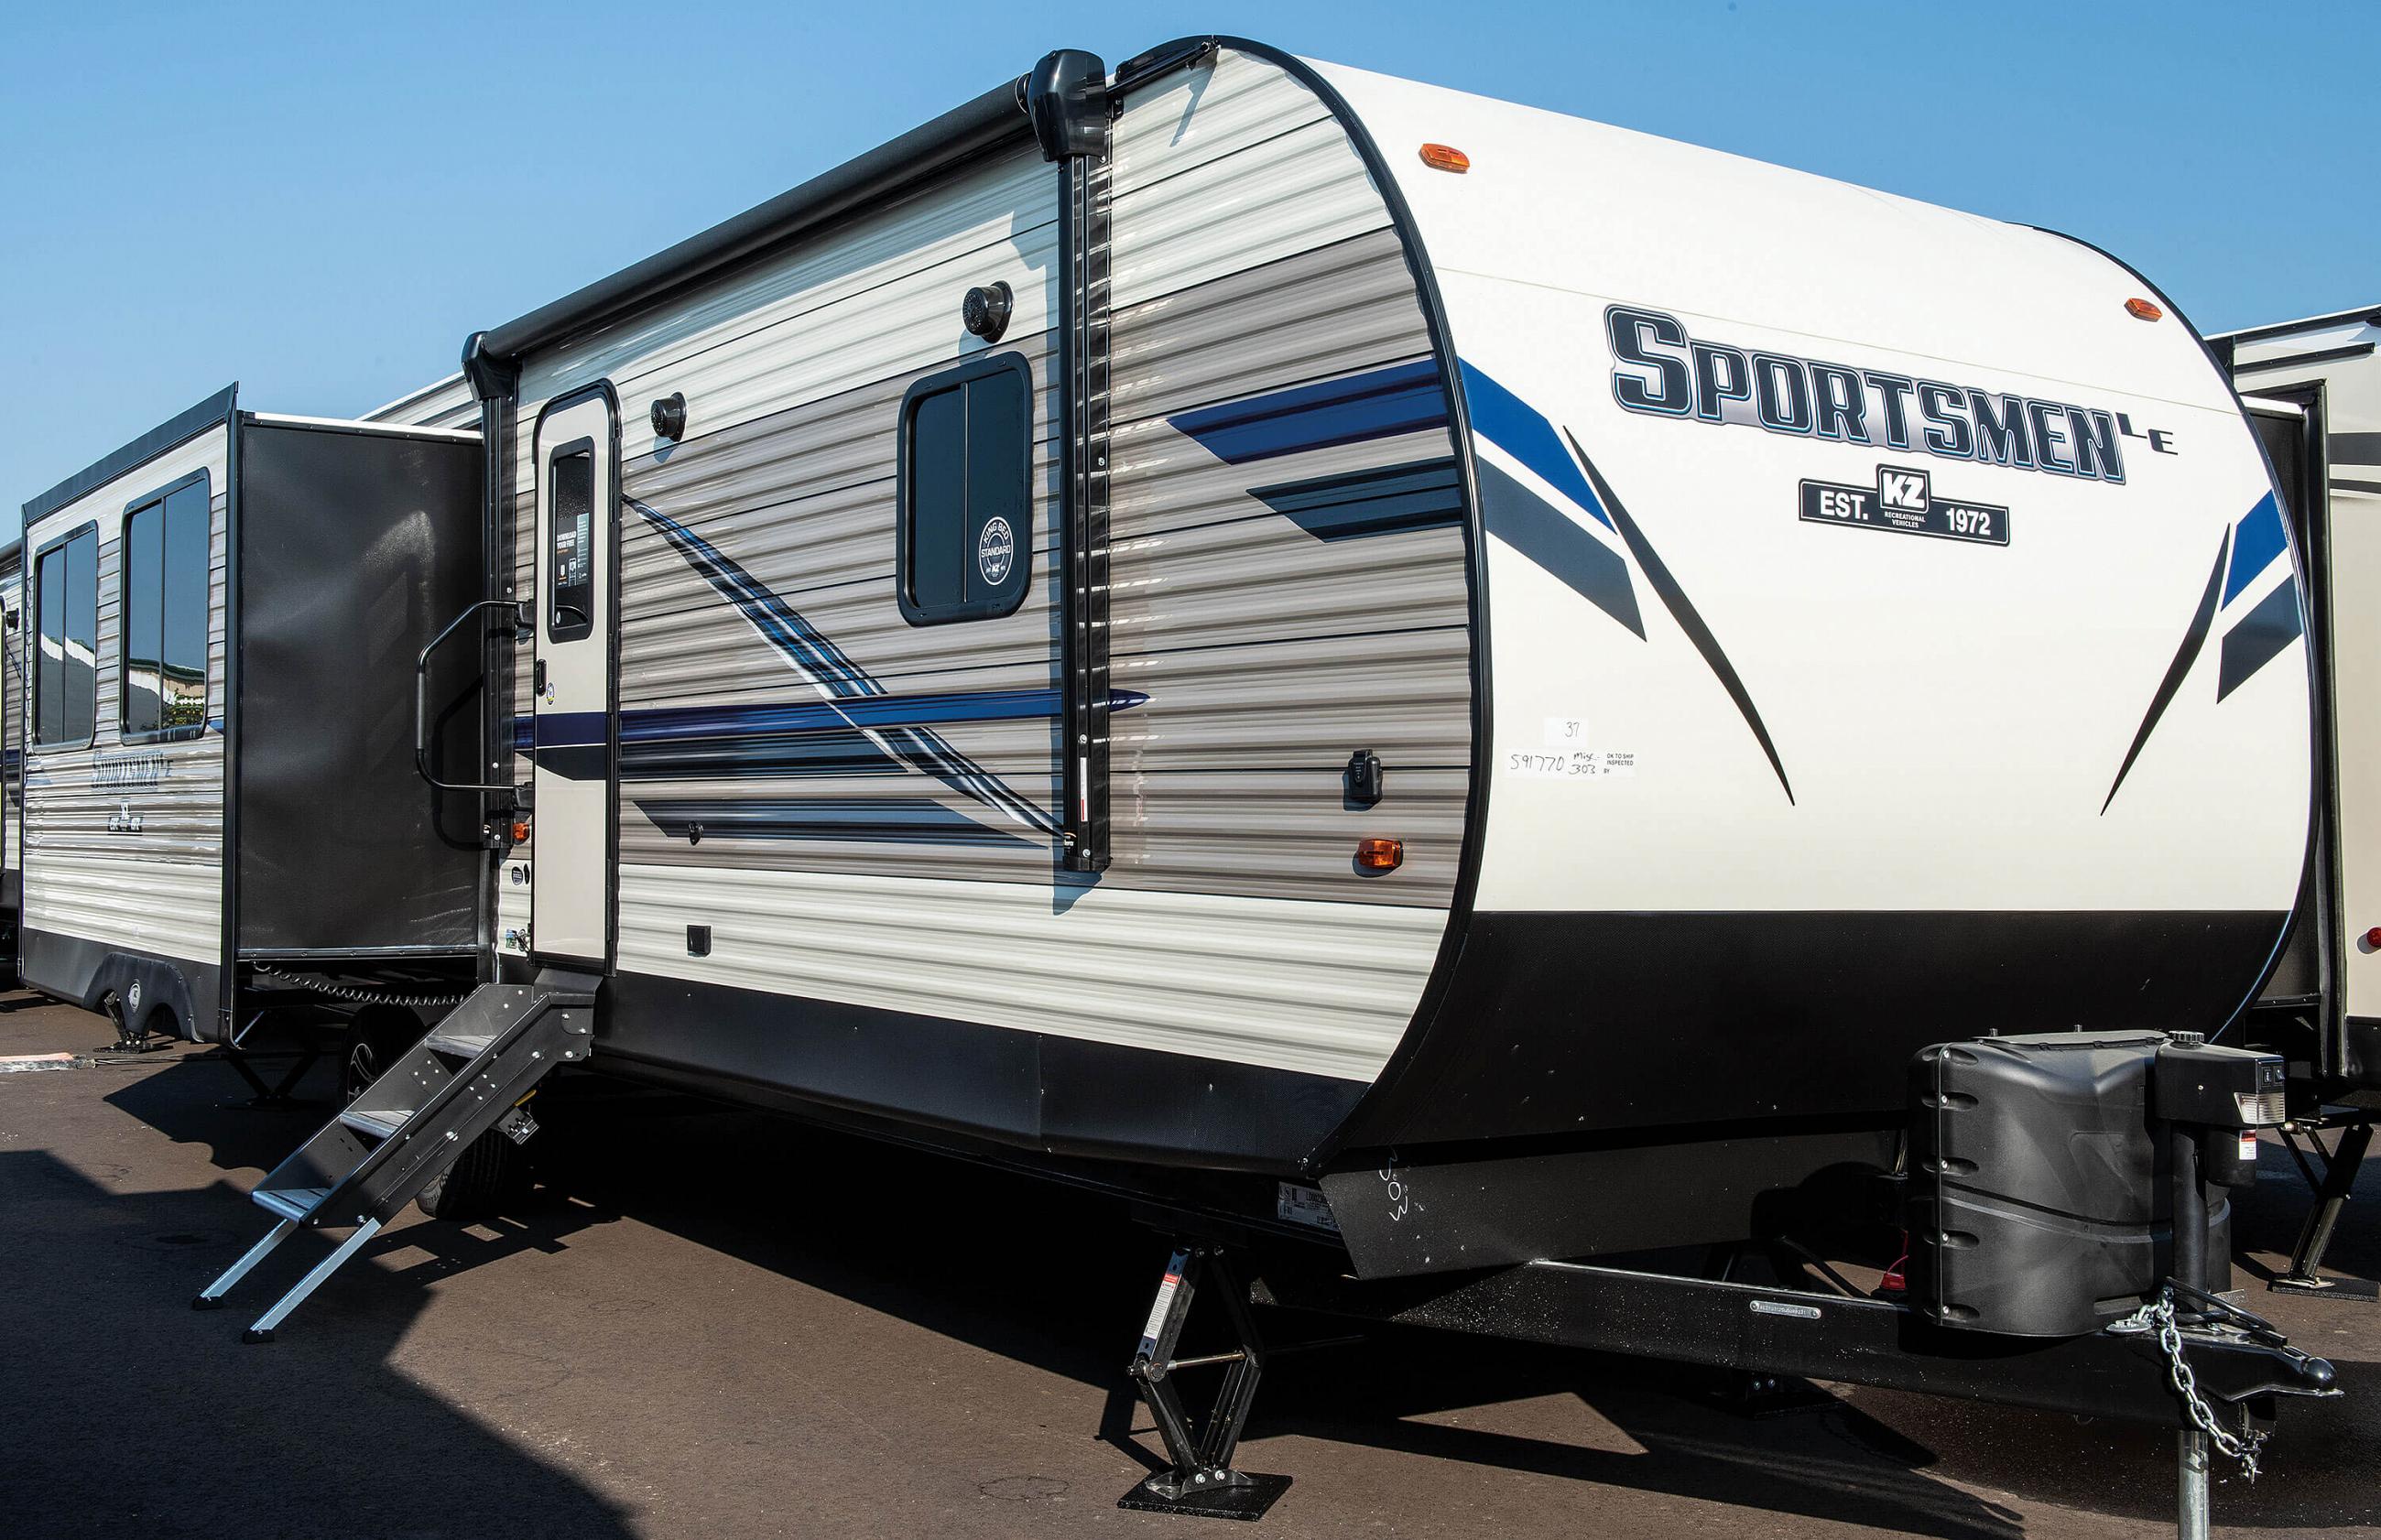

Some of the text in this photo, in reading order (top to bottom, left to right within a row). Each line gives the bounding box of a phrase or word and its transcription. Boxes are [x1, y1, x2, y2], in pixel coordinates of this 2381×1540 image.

[1604, 304, 2179, 485] SPORTSMEN LE
[1883, 472, 1924, 507] KZ
[1820, 490, 1991, 535] EST. 1972
[1885, 511, 1926, 523] RECREATIONAL
[1892, 518, 1919, 528] VEHICLES
[984, 523, 1009, 543] KING BED
[981, 545, 1010, 558] STANDARD
[1564, 721, 1581, 738] 37
